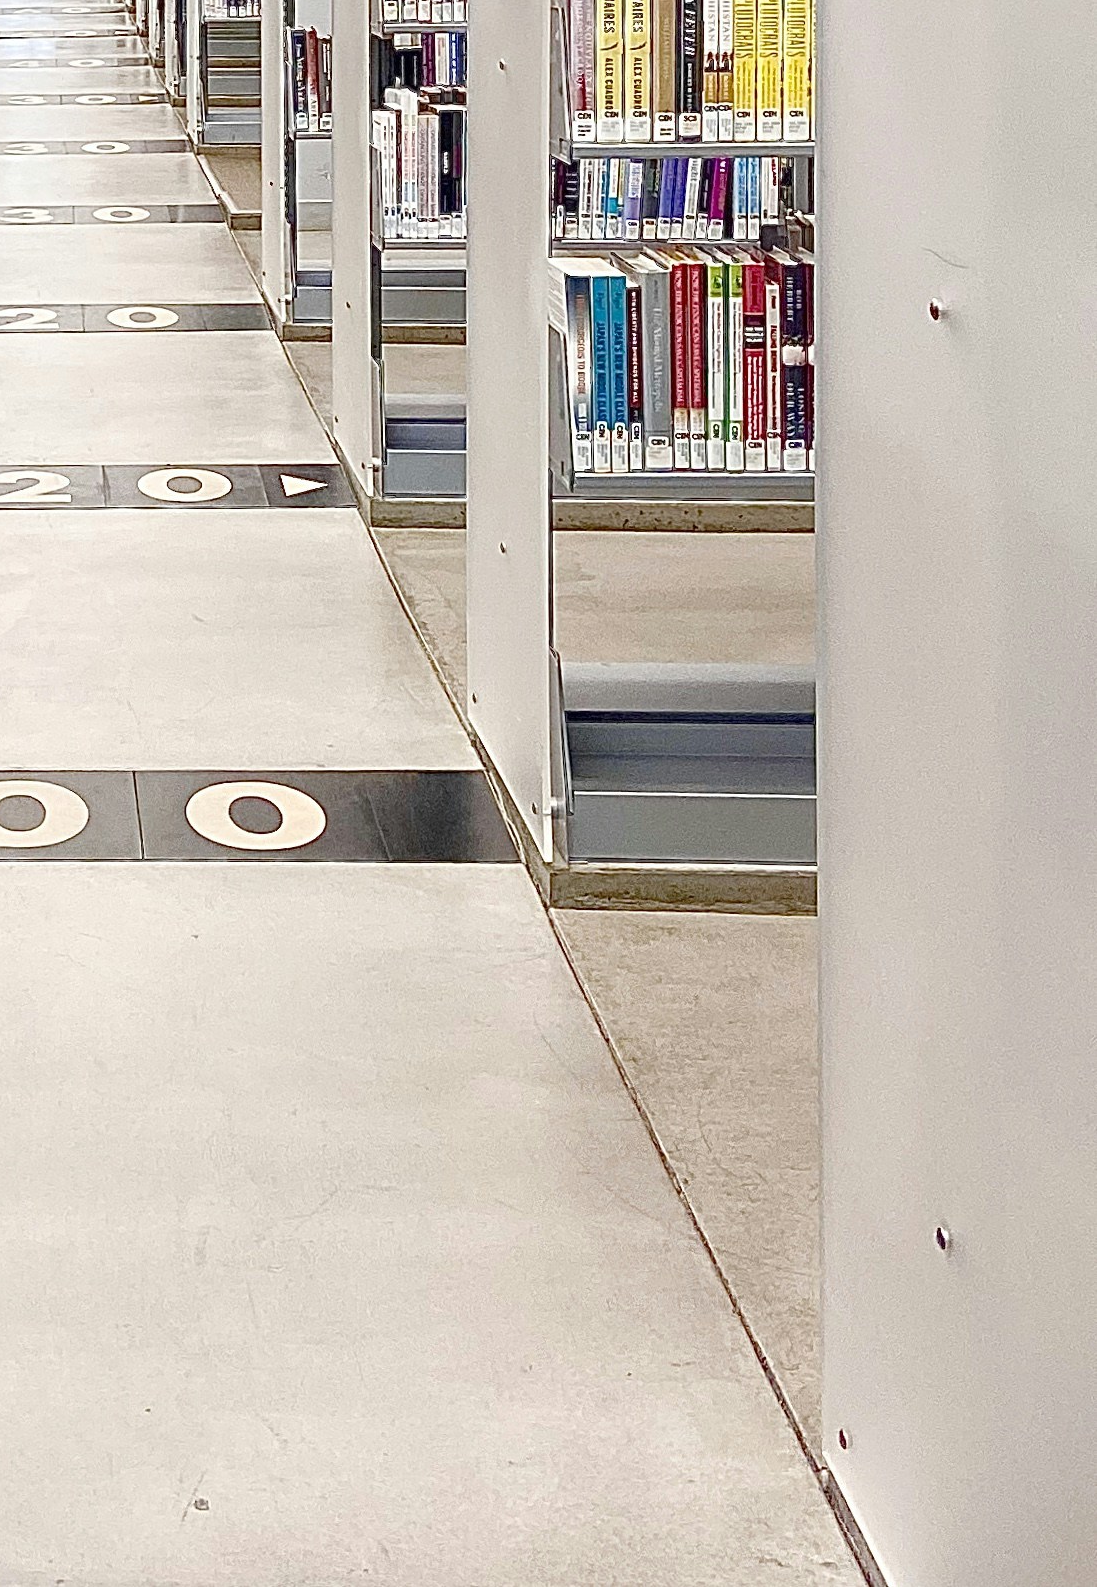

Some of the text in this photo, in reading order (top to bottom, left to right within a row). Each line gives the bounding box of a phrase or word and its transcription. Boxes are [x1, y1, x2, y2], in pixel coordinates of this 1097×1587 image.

[685, 8, 696, 56] FEVER
[603, 58, 615, 77] ALEX
[632, 57, 644, 76] ALEX
[603, 79, 615, 110] CUADRO
[632, 79, 644, 110] CUADRO
[786, 276, 794, 322] HERBERT
[596, 322, 606, 352] JAPAN'S
[614, 322, 624, 352] JAPAN'S
[786, 383, 794, 409] OUR
[797, 387, 805, 433] LOSING
